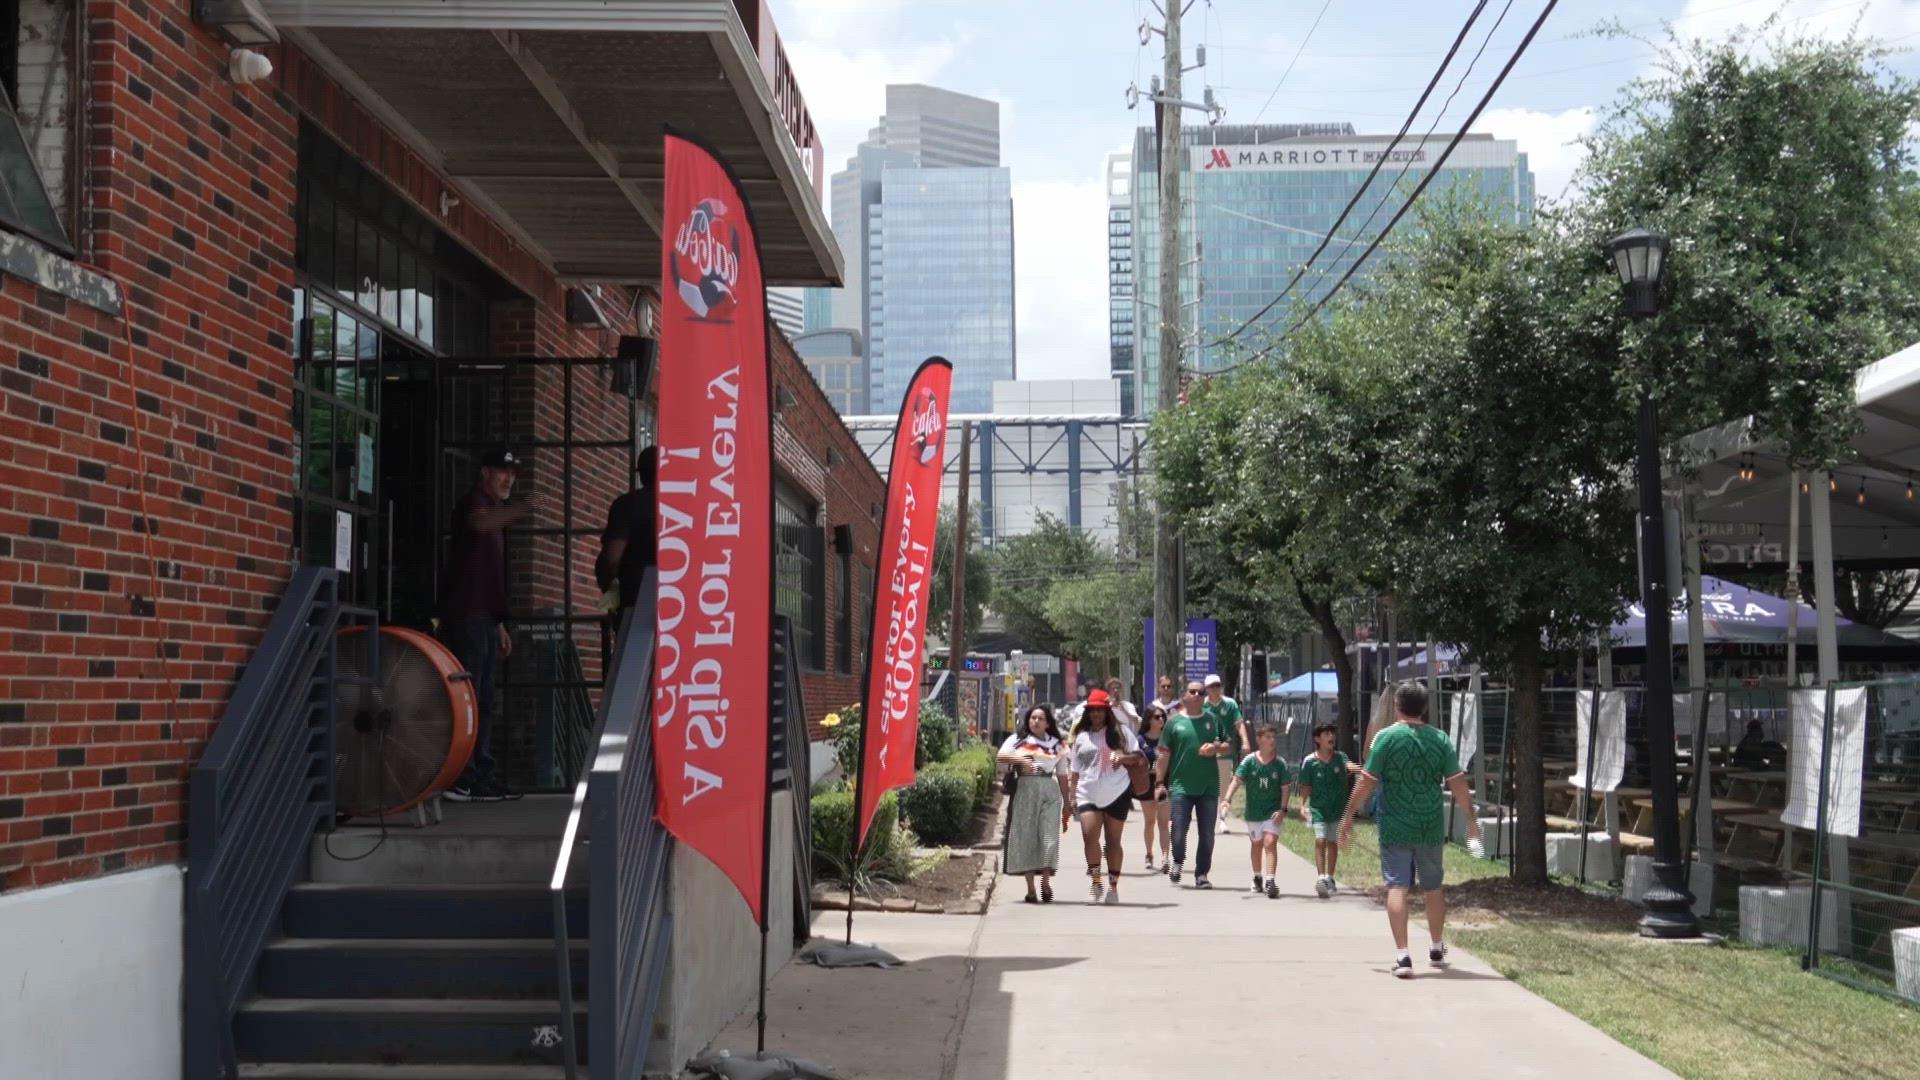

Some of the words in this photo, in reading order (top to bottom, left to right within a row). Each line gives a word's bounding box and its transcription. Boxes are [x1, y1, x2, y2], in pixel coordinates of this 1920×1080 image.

[1239, 149, 1358, 164] MARRIOTT
[891, 482, 917, 597] Every
[885, 601, 902, 666] For
[1739, 643, 1786, 657] ULTR
